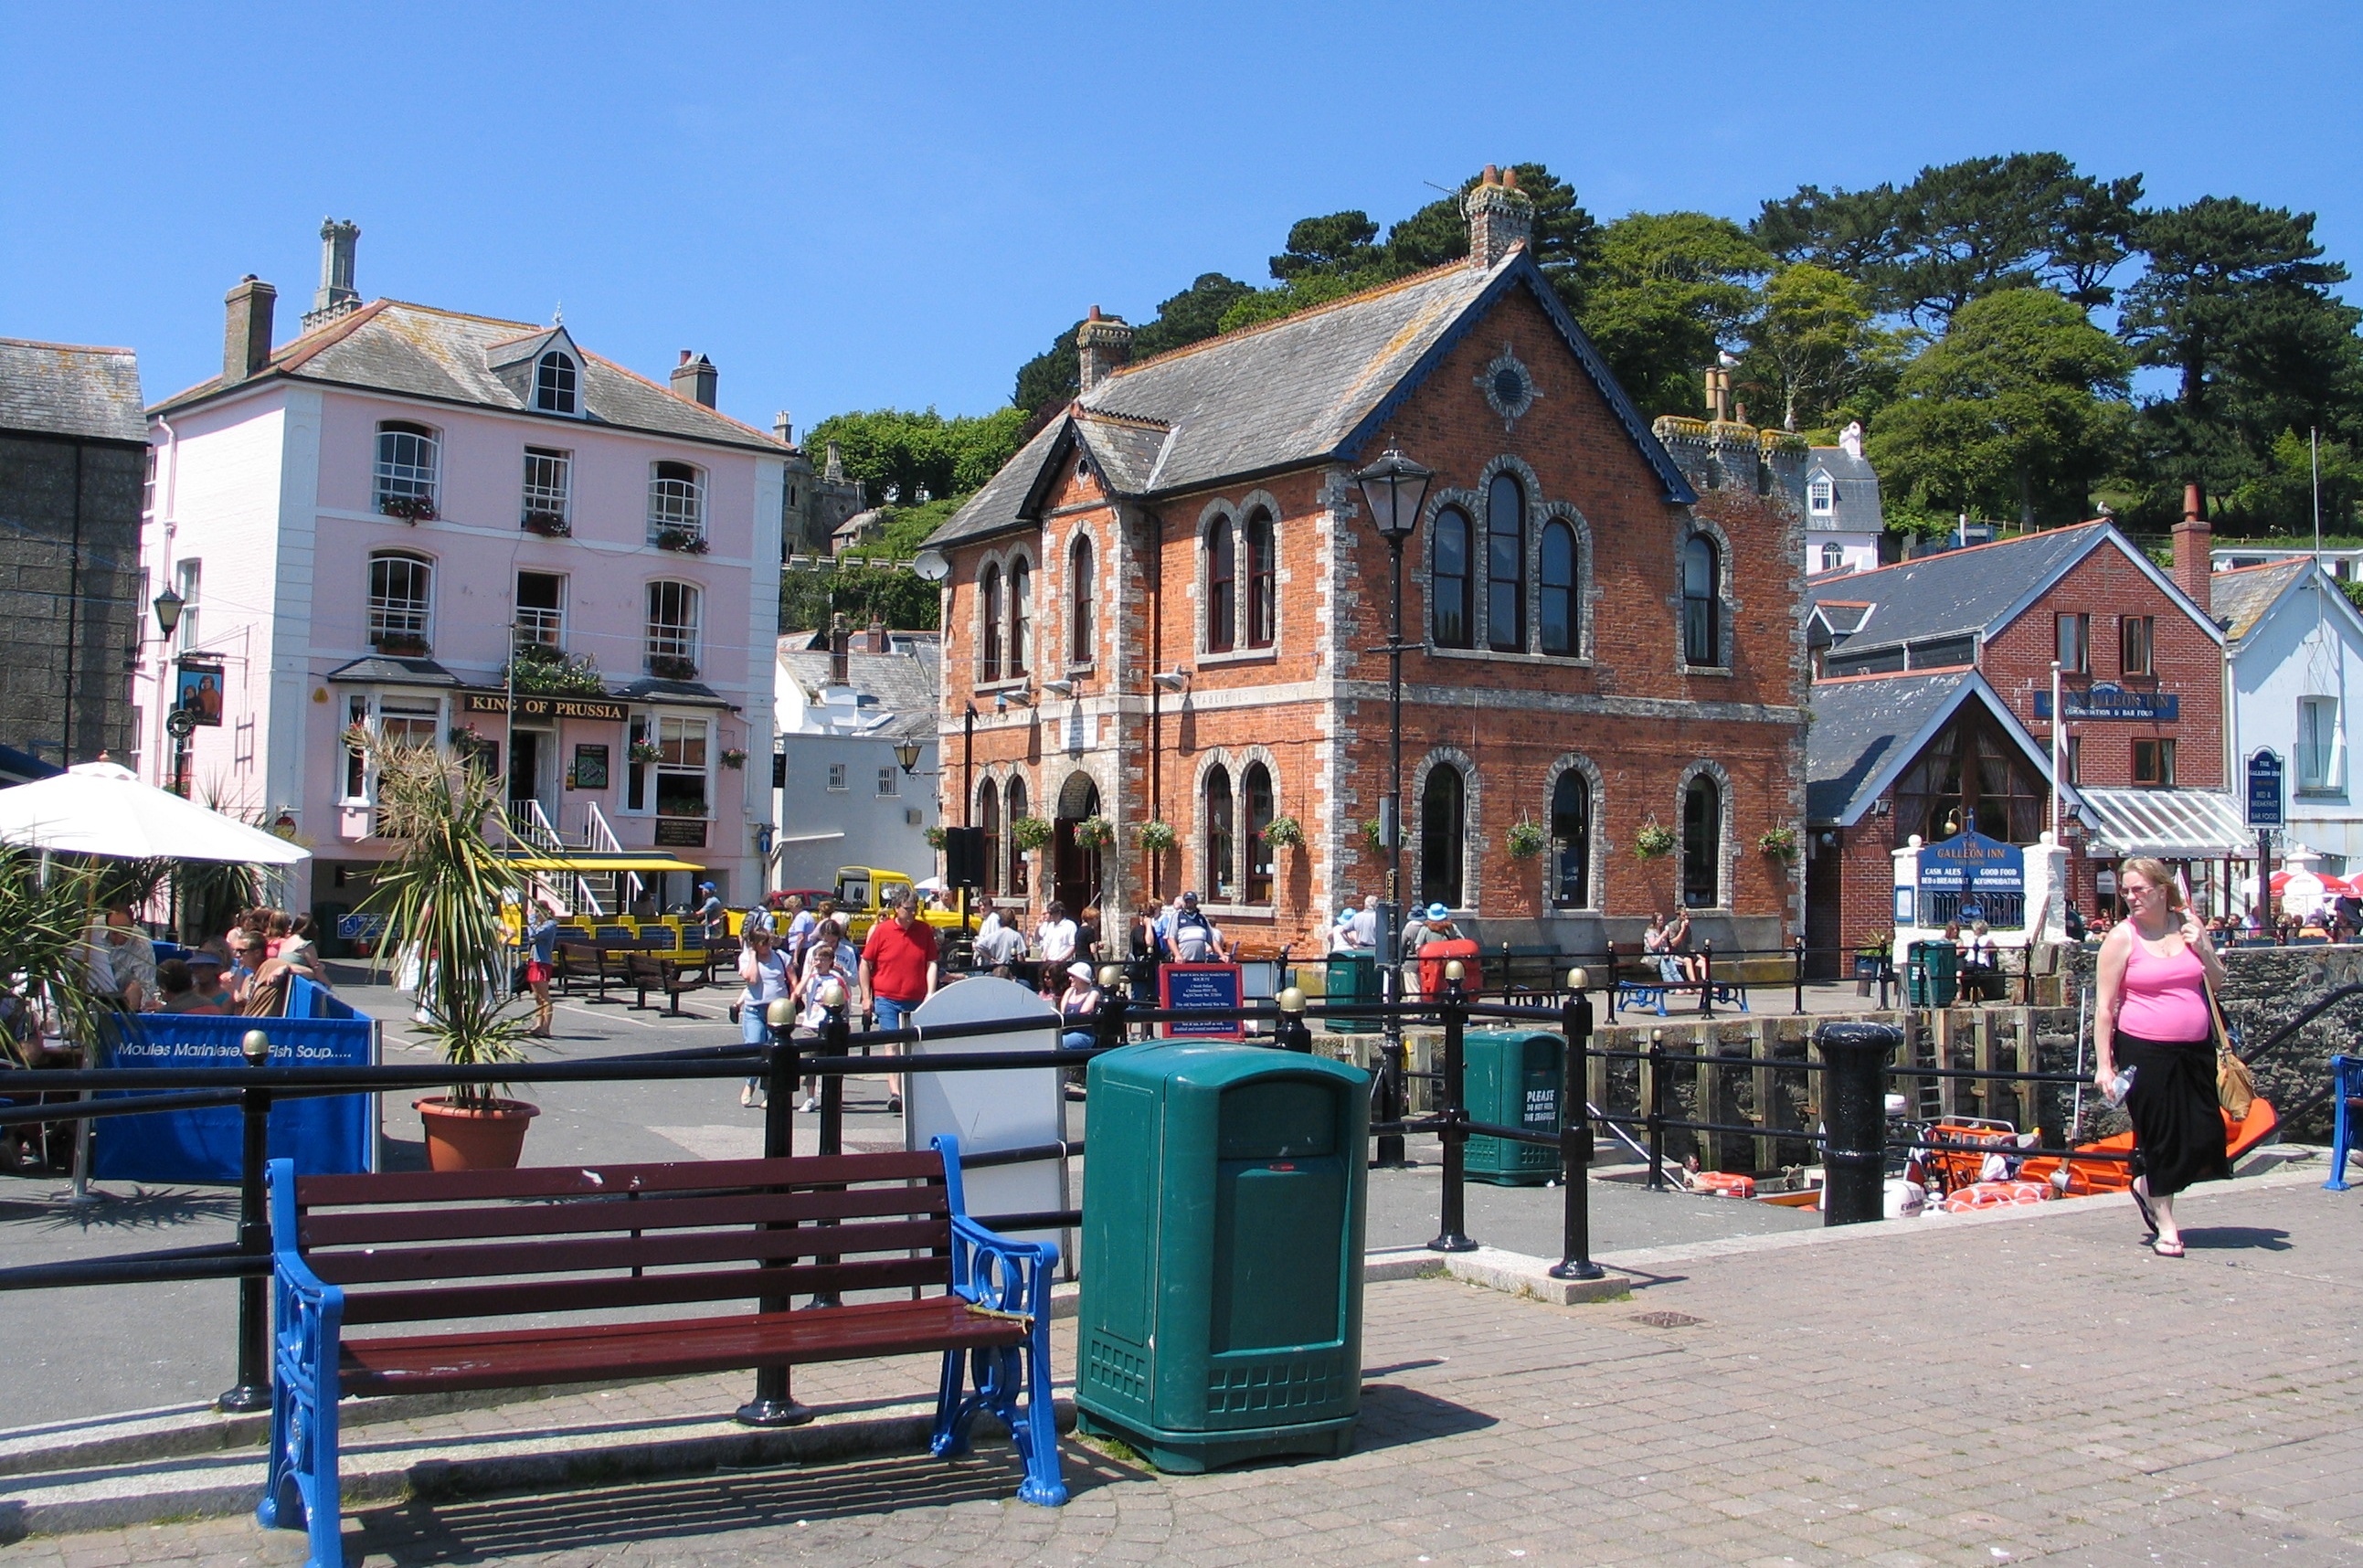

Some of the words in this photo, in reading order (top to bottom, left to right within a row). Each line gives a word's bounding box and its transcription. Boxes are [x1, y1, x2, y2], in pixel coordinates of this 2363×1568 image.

[472, 696, 519, 711] KING
[525, 700, 548, 713] OF
[556, 702, 621, 718] PRUSSIA
[1937, 849, 1984, 859] GALLEON
[1987, 849, 2005, 859] INN
[1924, 867, 1942, 875] CASK
[1944, 867, 1962, 875] ALES
[1980, 868, 1998, 876] GOOD
[2000, 868, 2018, 876] FOOD
[118, 1043, 170, 1056] Moules
[268, 1044, 291, 1057] Fish
[1526, 1090, 1554, 1102] PLEASE
